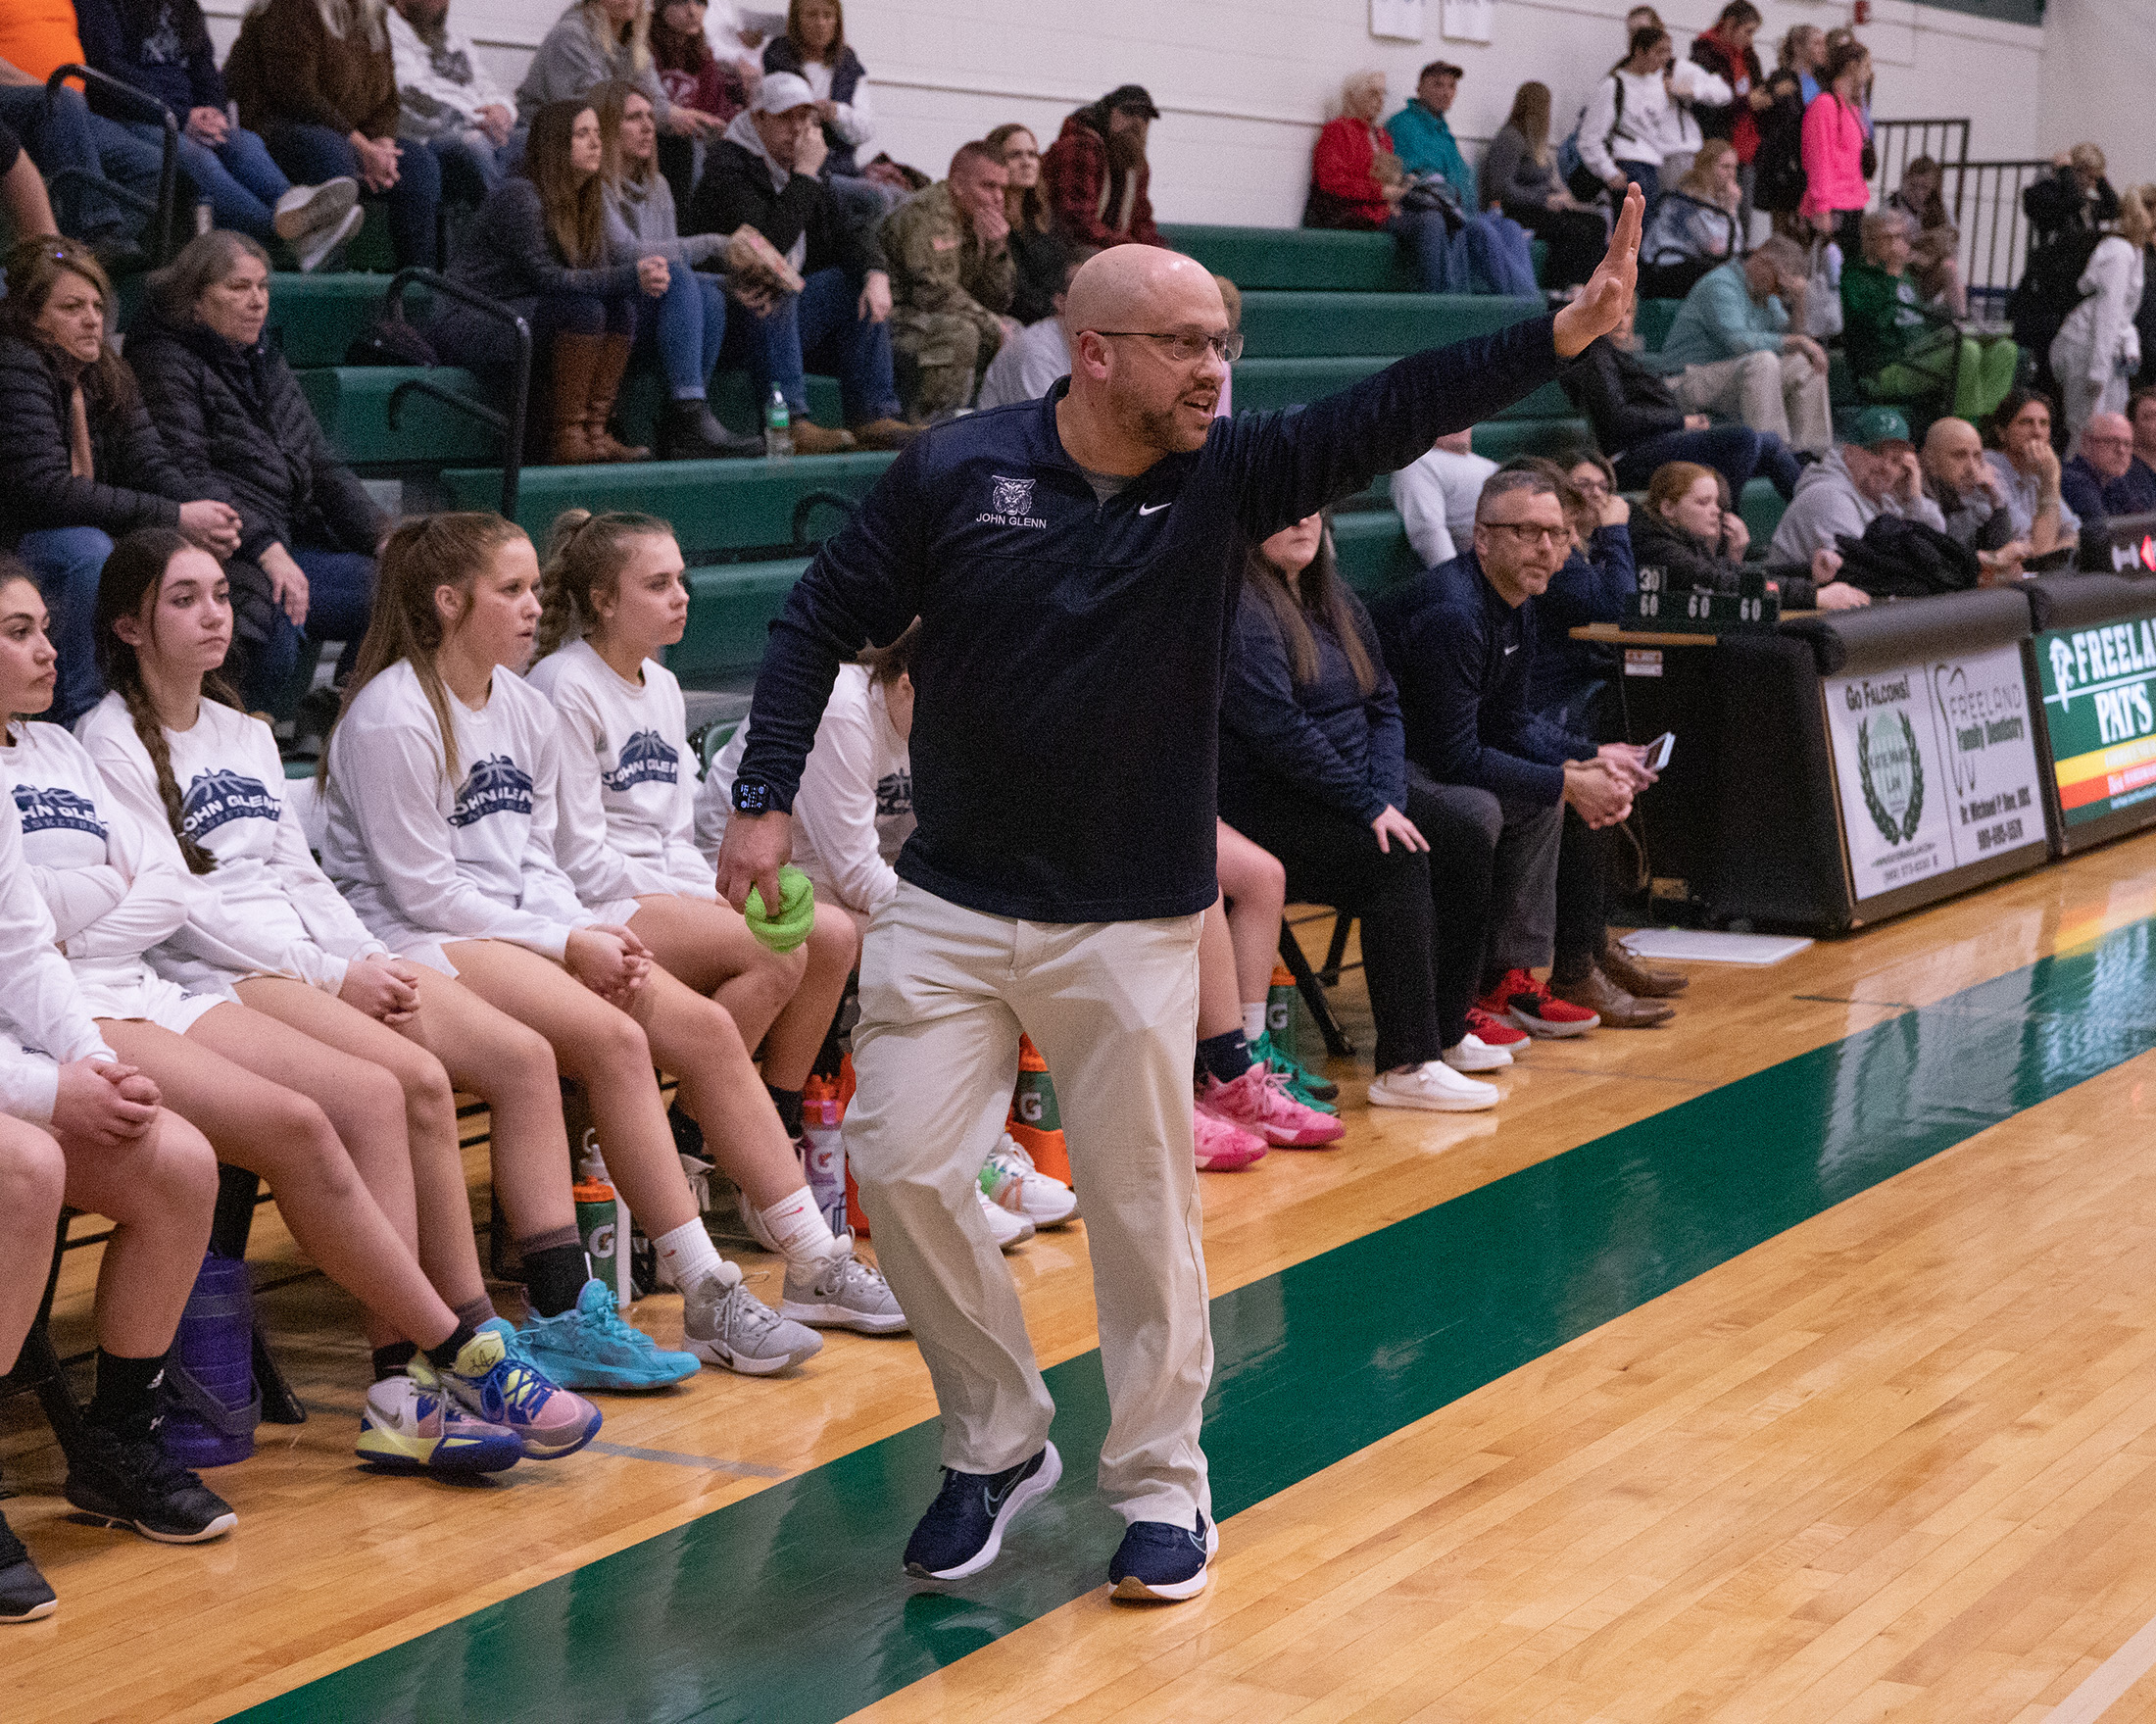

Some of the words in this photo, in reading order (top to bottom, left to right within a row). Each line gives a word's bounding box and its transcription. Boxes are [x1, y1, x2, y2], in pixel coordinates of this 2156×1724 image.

[975, 513, 1006, 525] JOHN
[1008, 516, 1047, 529] GLENN
[2072, 616, 2156, 684] FREELA
[2093, 681, 2153, 745] PAT'S
[182, 799, 224, 832] OHN
[1266, 1002, 1289, 1031] G
[1020, 1091, 1043, 1122] G
[589, 1222, 615, 1259] G
